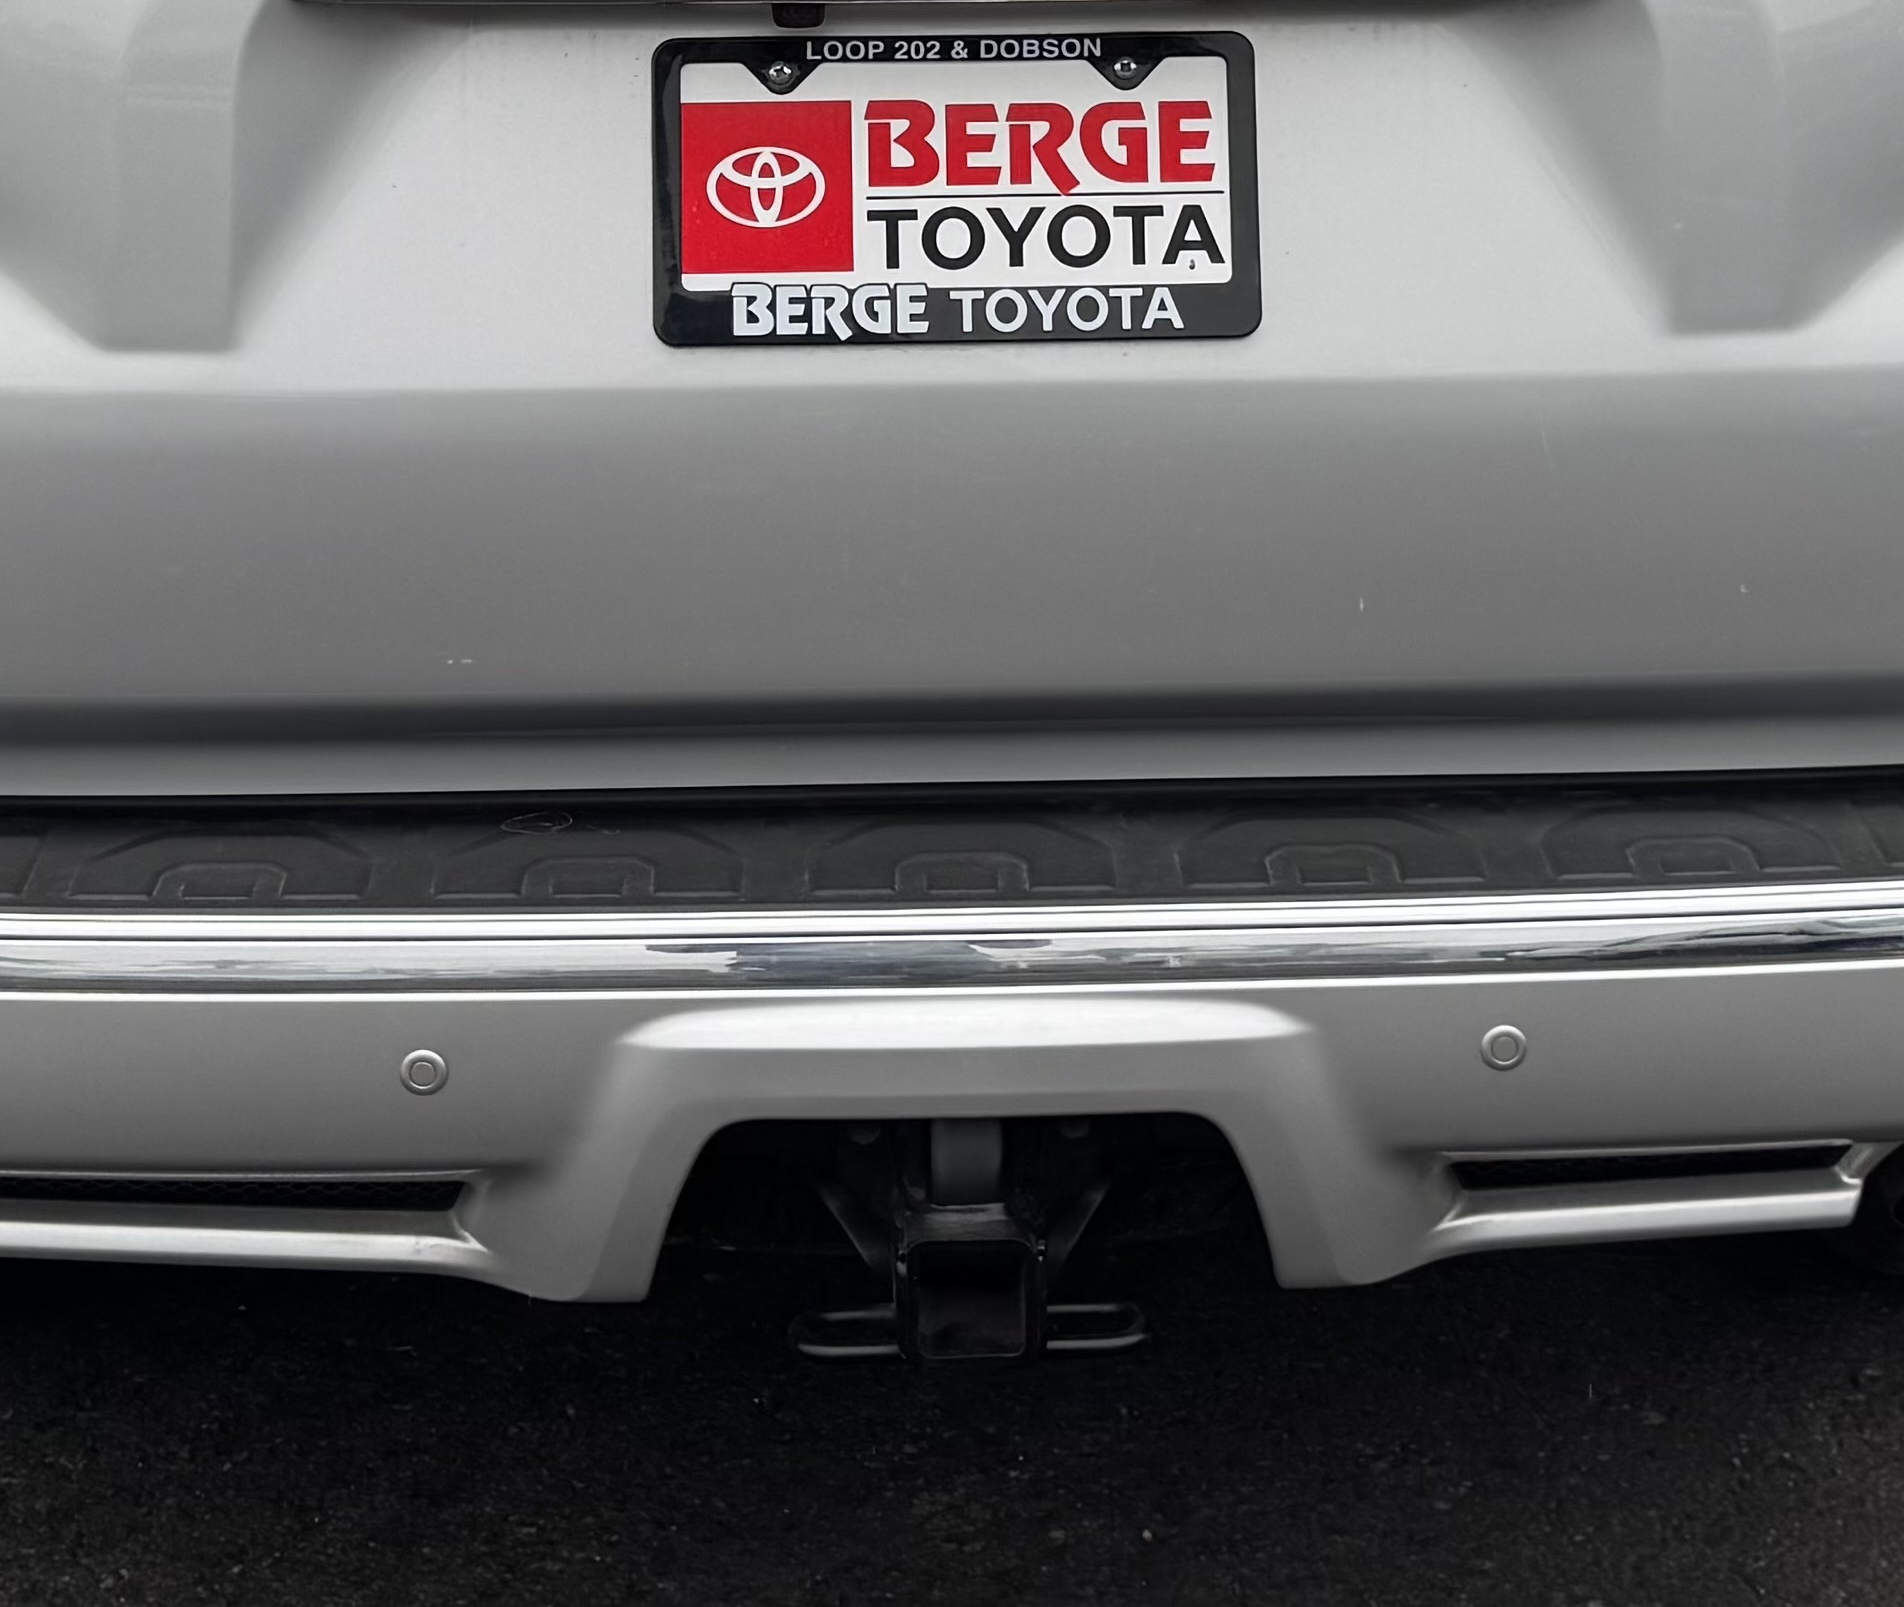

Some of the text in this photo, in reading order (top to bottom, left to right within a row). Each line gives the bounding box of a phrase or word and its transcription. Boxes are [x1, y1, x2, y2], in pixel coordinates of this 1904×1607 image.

[806, 38, 1102, 60] LOOP 202 & DOBSON
[864, 100, 1216, 195] BERGE
[867, 205, 1225, 269] TOYOTA
[731, 283, 1184, 341] BERGE TOYOTA
